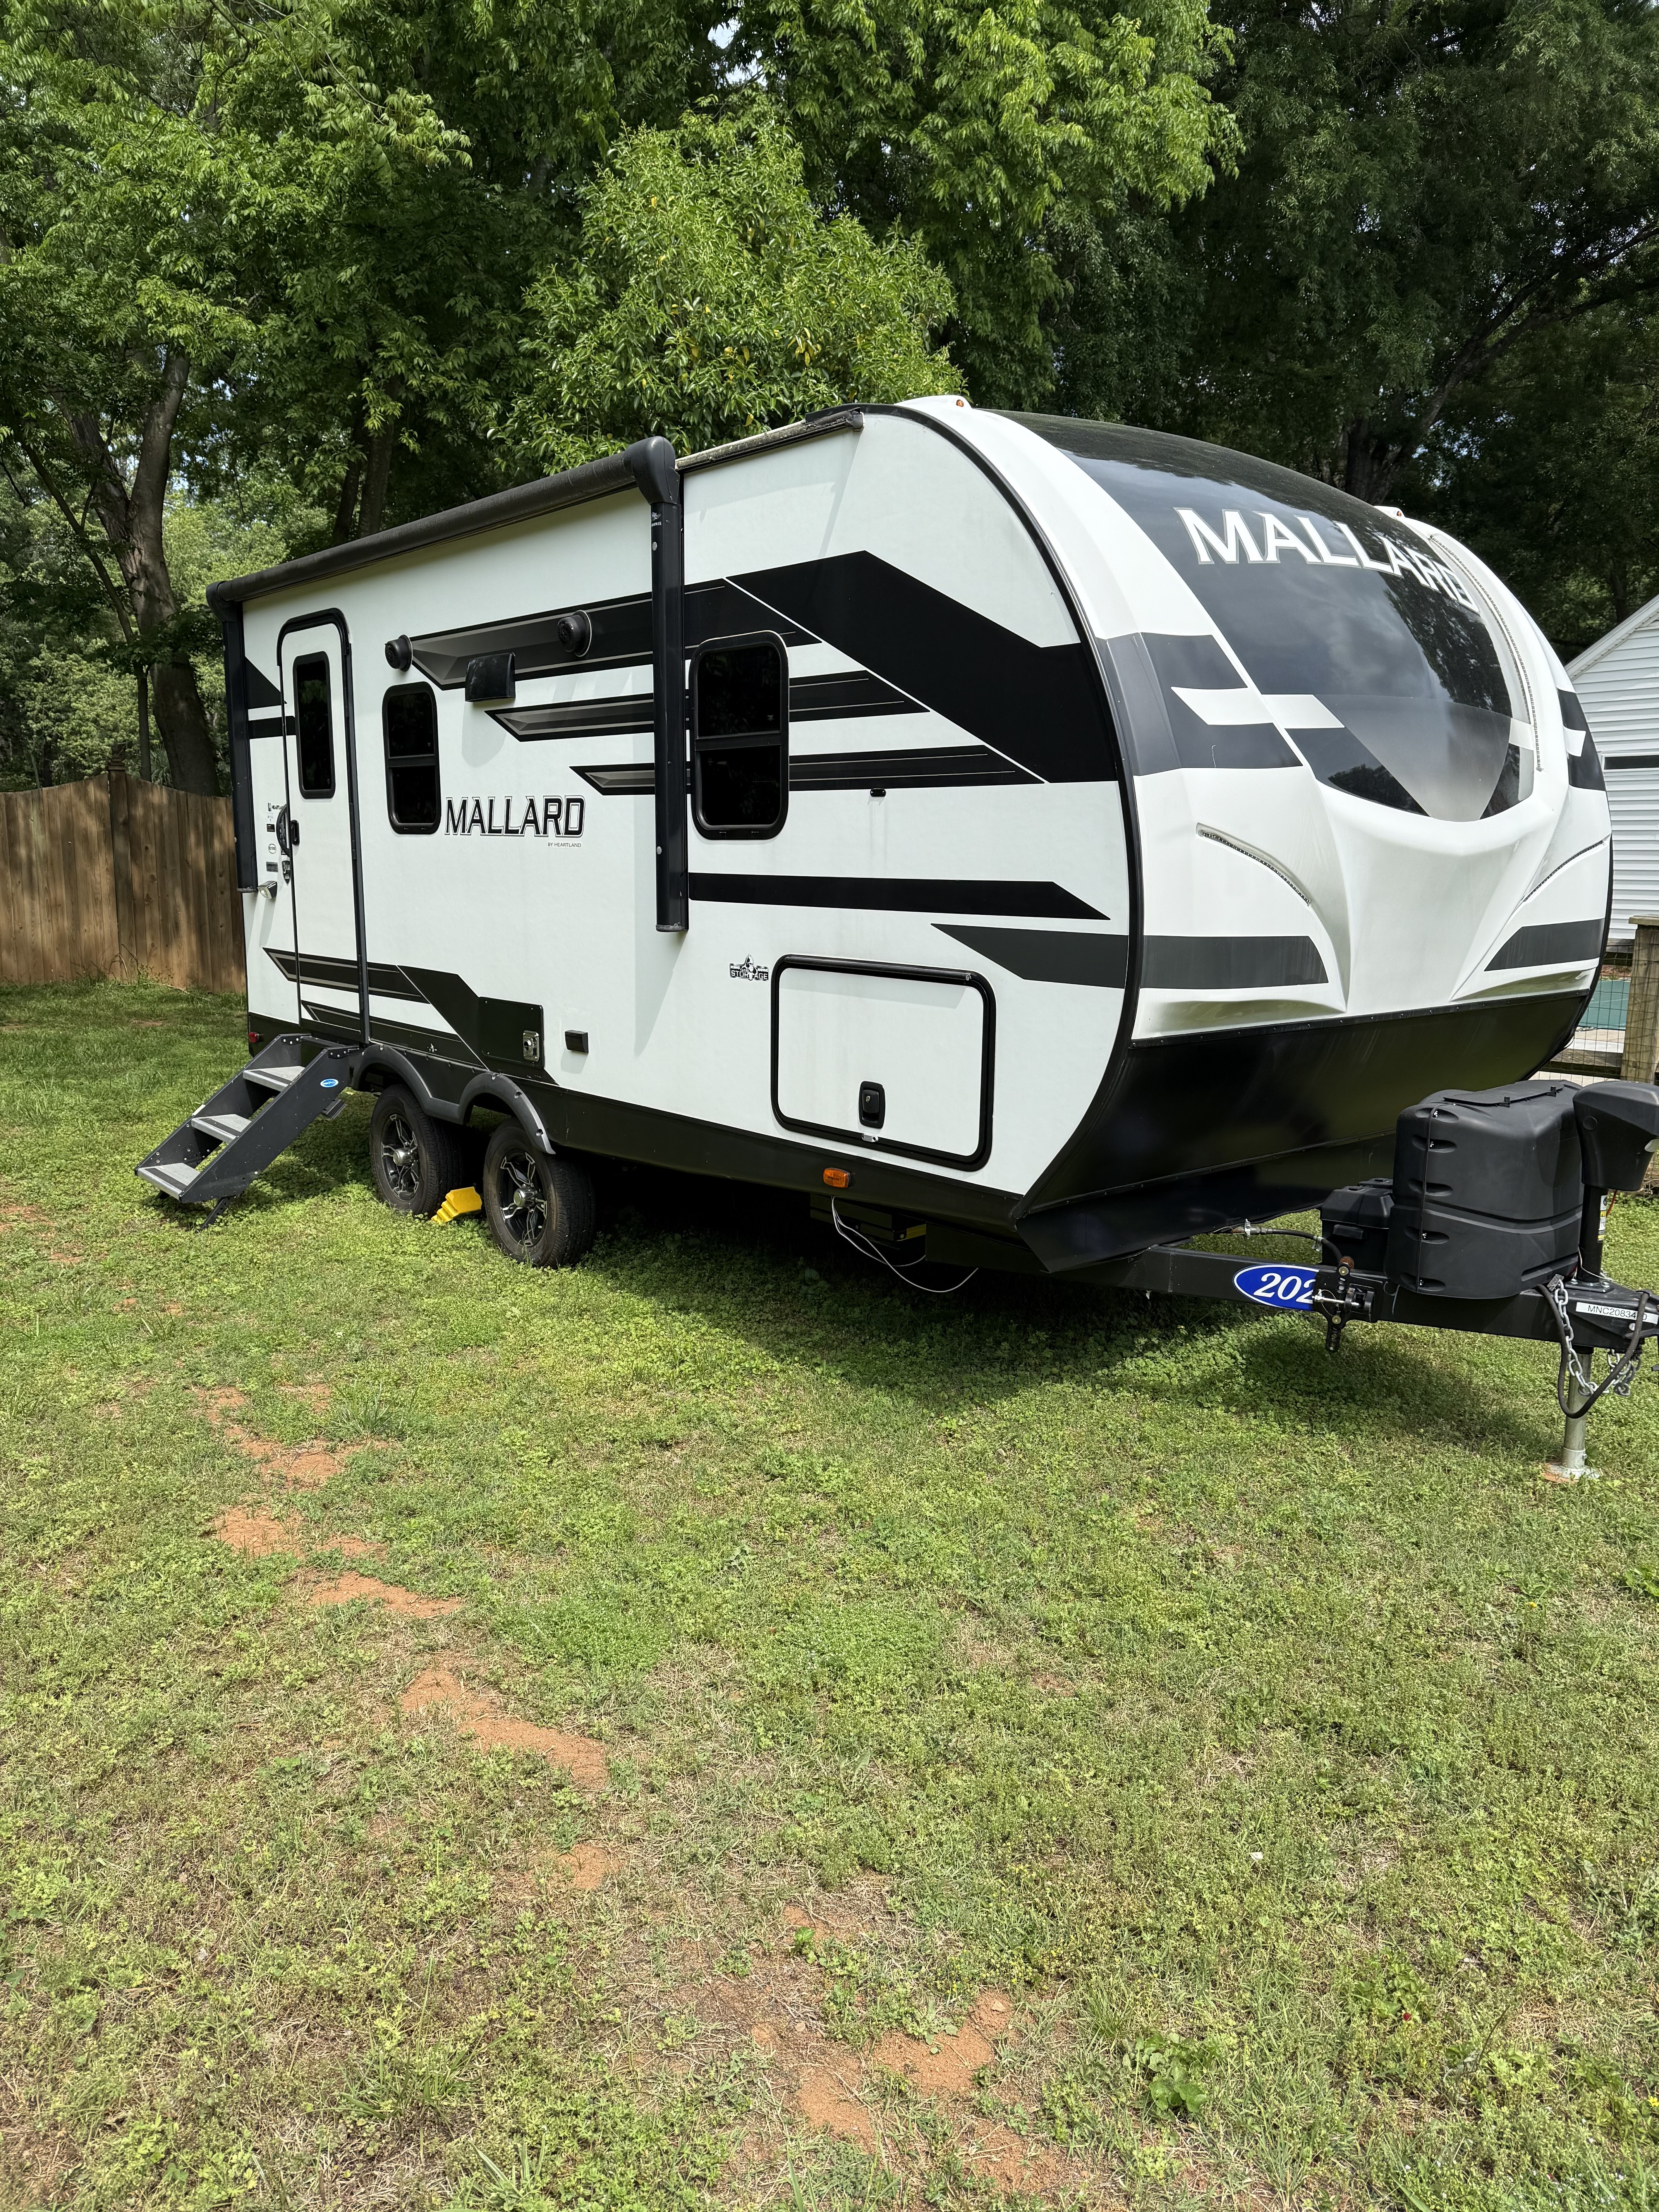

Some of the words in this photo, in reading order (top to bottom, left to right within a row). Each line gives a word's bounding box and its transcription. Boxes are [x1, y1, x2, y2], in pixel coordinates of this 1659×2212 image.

[1174, 507, 1480, 613] MALLARD
[445, 795, 585, 837] MALLARD
[731, 970, 768, 979] STORAGE
[1588, 1305, 1647, 1321] MNC208340
